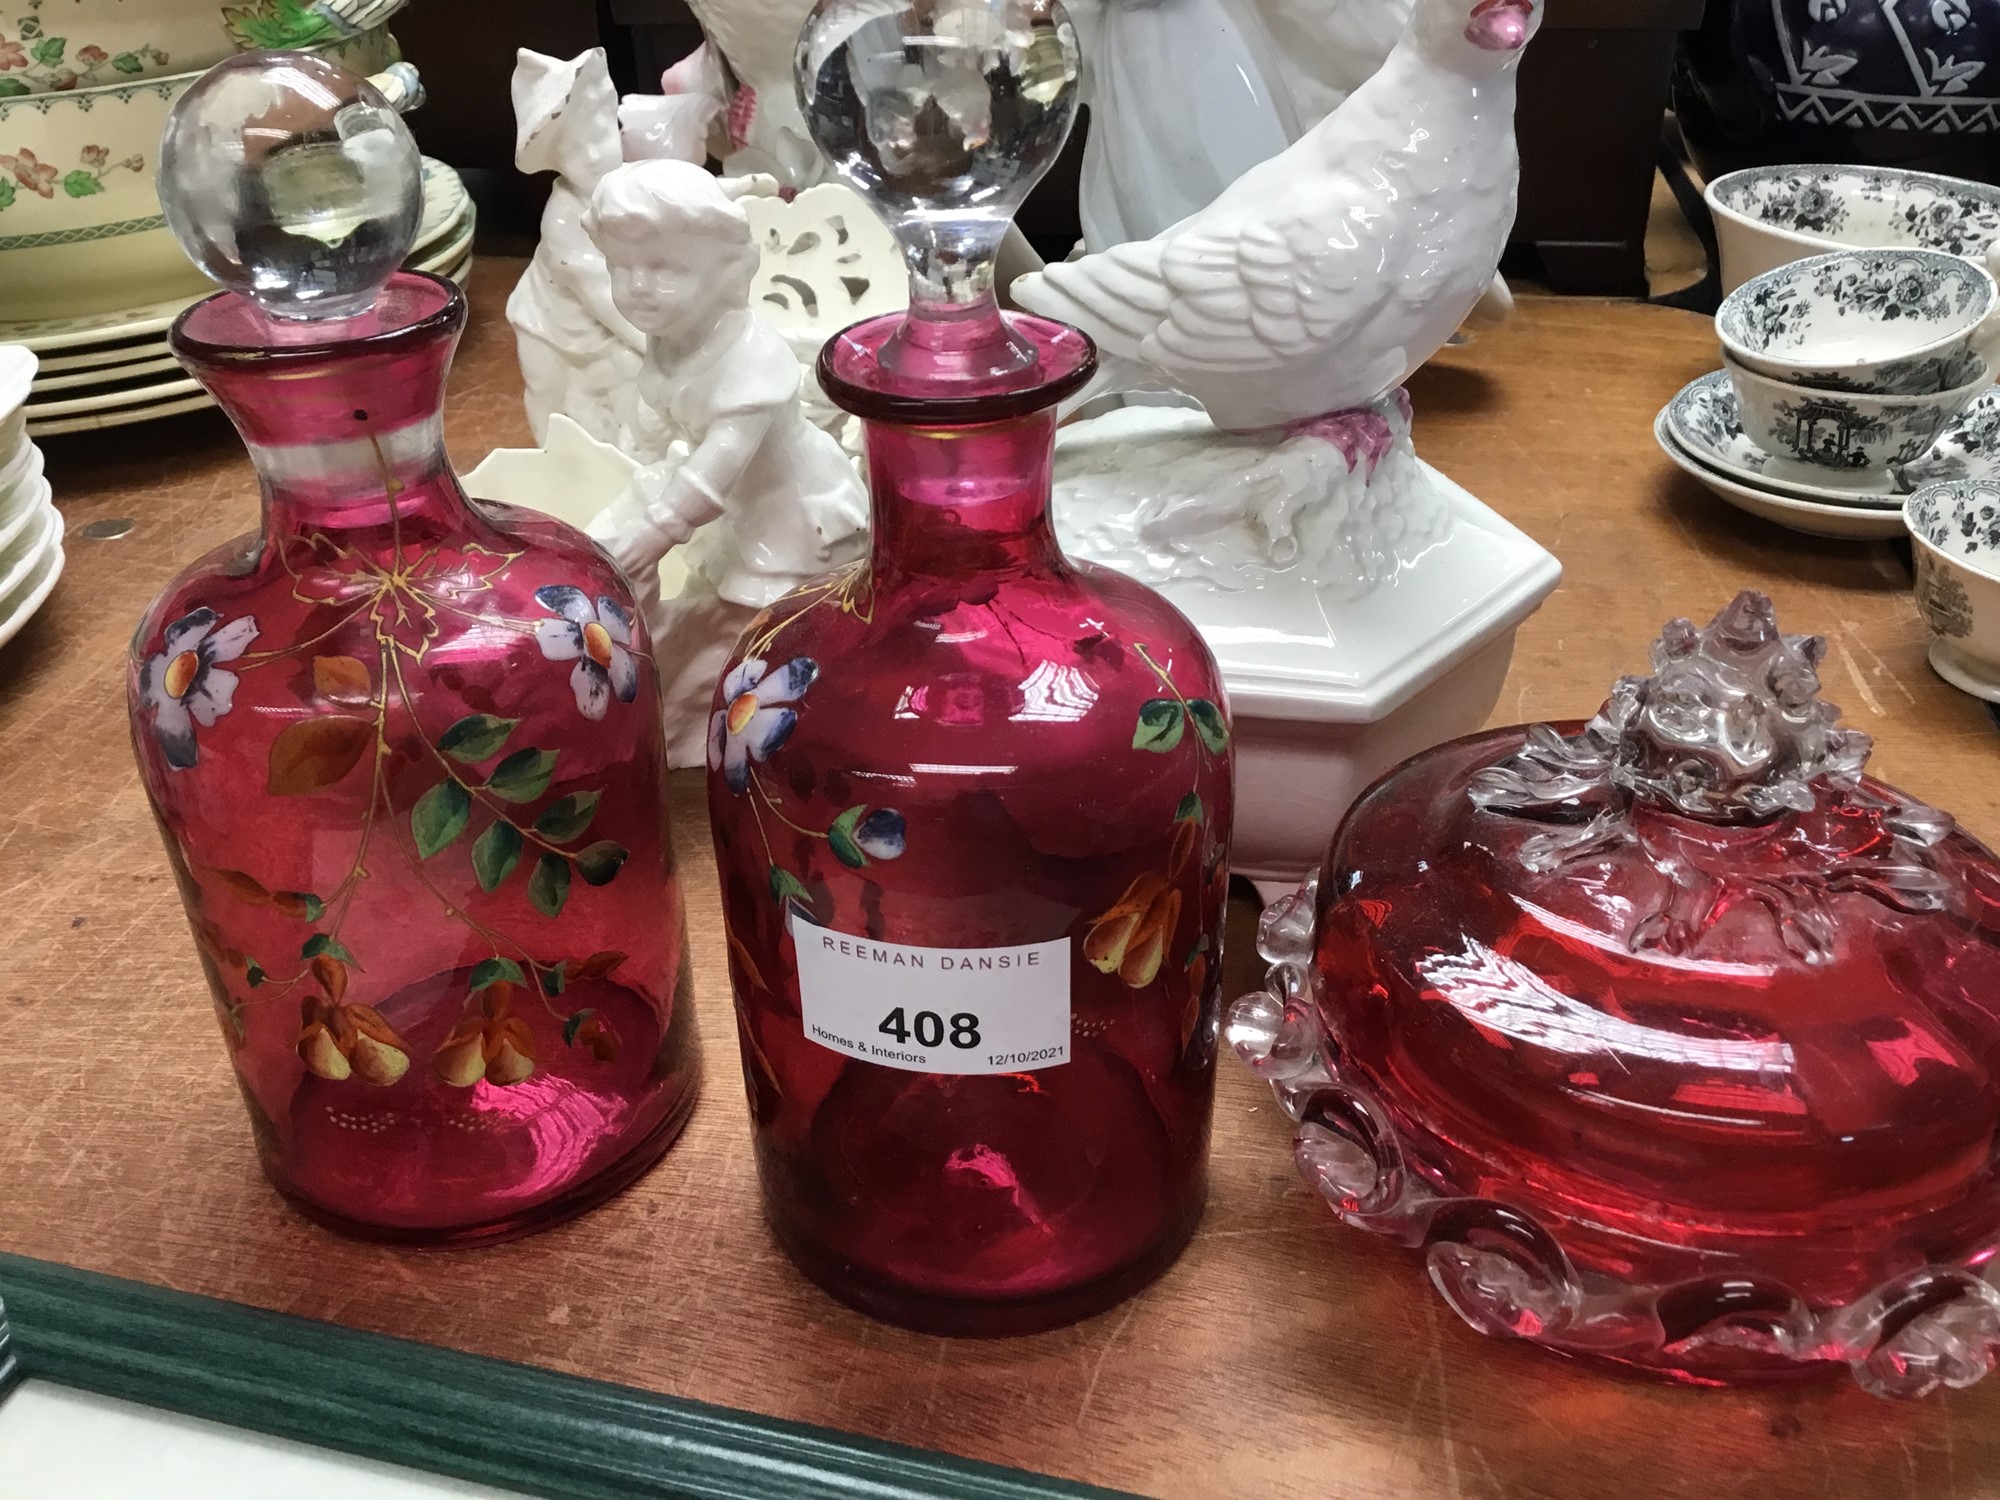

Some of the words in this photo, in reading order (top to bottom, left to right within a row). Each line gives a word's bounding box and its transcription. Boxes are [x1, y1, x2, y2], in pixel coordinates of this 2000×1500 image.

[822, 936, 924, 968] REEMAN
[941, 952, 1040, 970] DANSIE
[812, 1024, 854, 1049] Homes
[858, 1042, 868, 1053] &
[872, 1045, 926, 1064] Interiors
[878, 1007, 982, 1049] 408
[987, 1046, 1064, 1066] 12/10/2021
